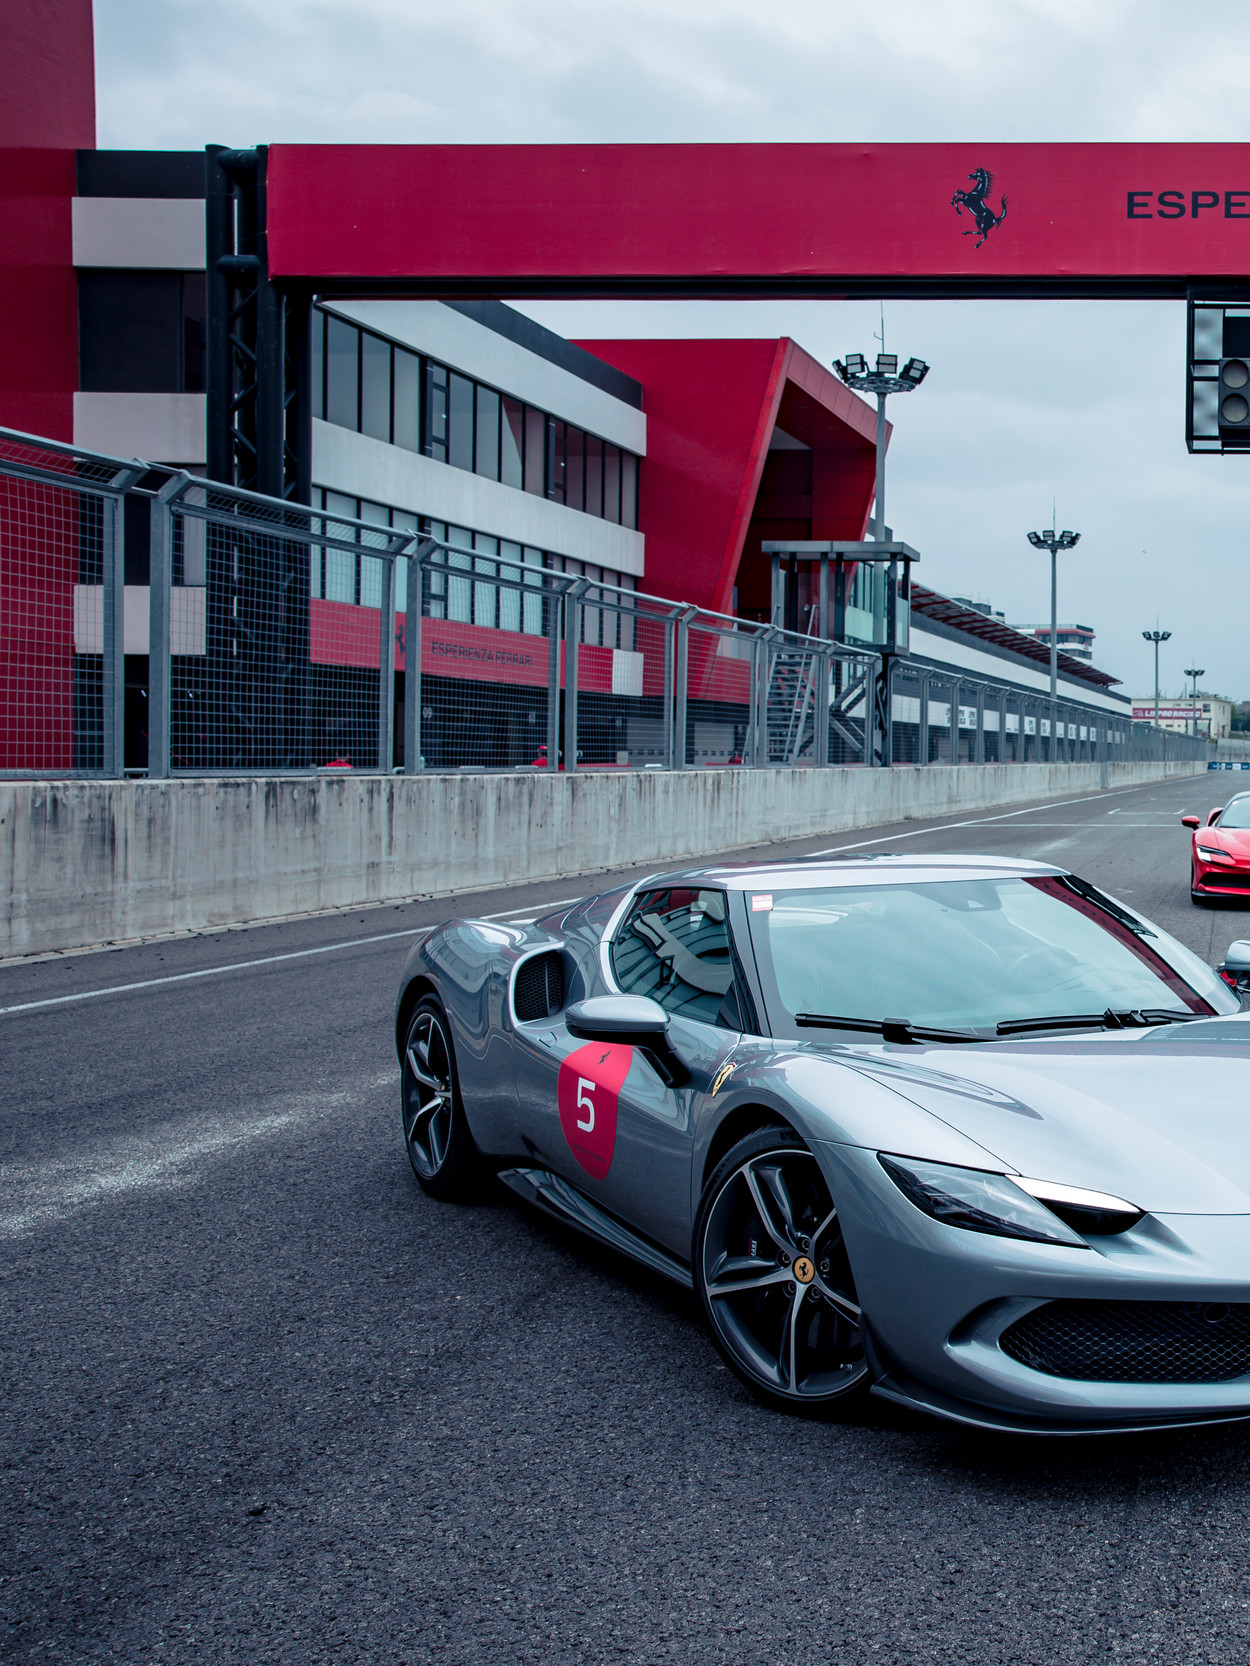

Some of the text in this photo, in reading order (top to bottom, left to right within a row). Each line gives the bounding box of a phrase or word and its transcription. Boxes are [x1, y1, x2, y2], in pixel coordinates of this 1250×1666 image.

[431, 642, 533, 666] ESPERIENZA FERRARI
[577, 1076, 596, 1133] 5
